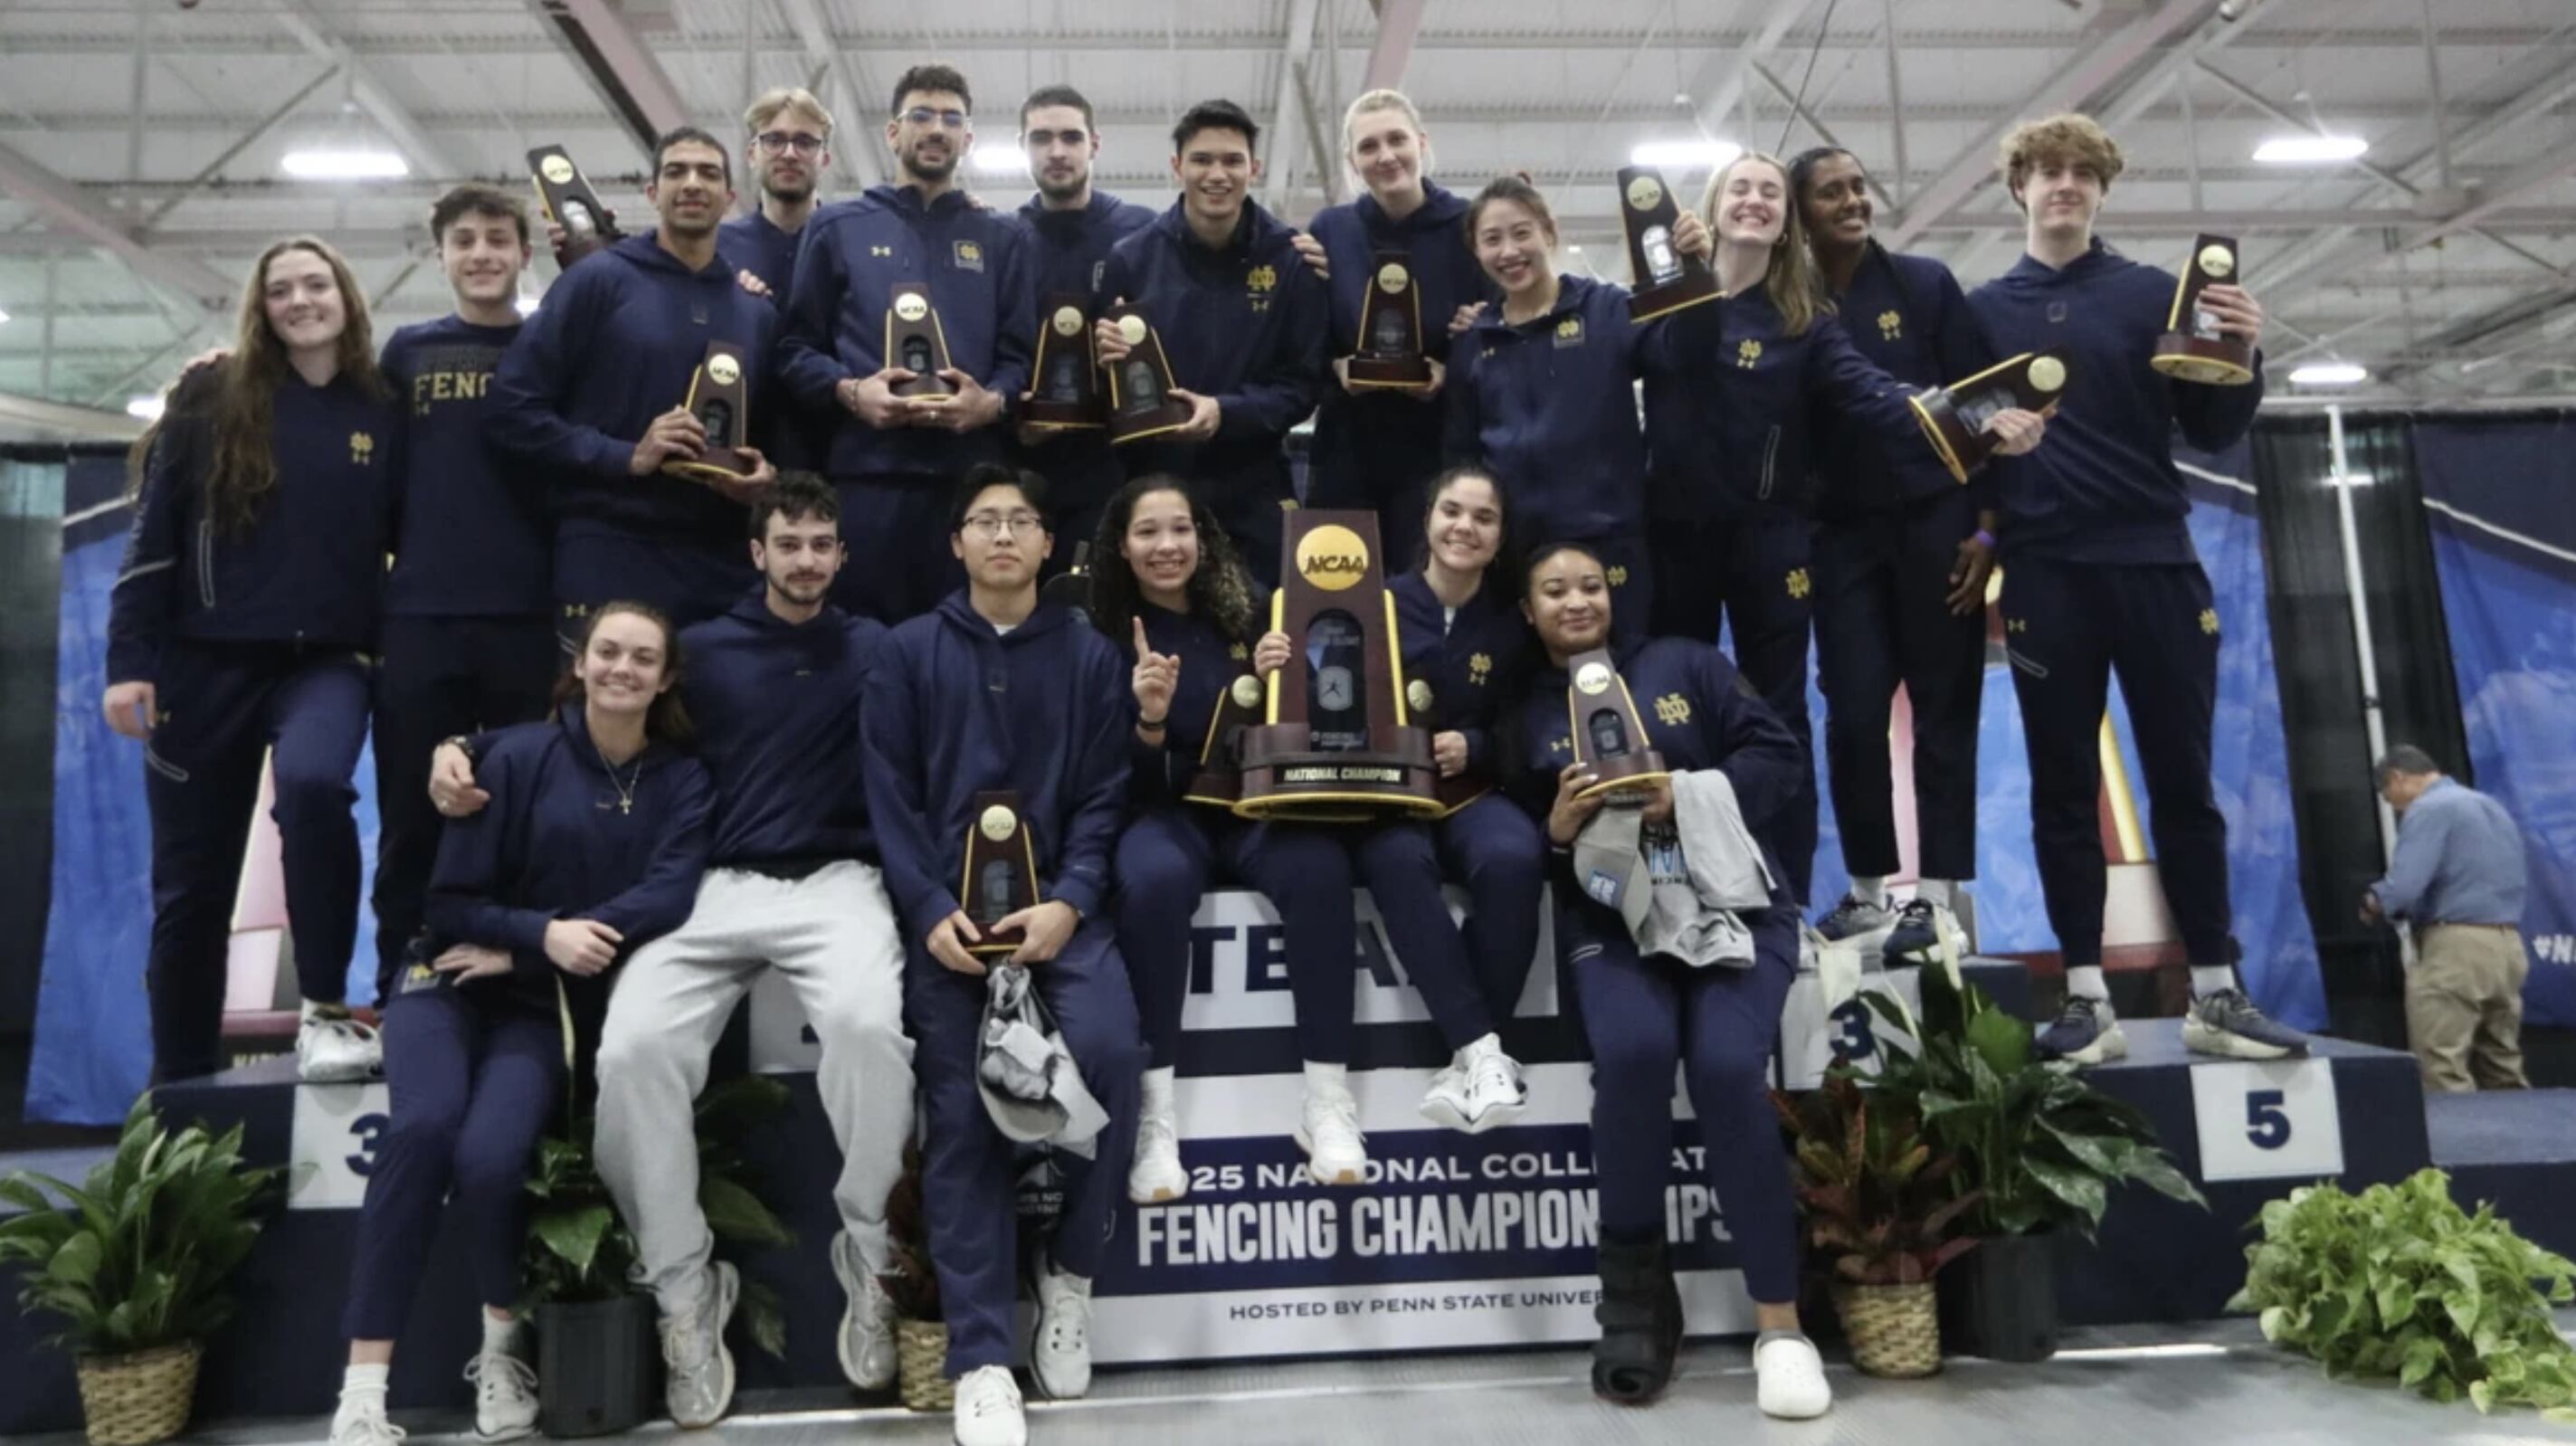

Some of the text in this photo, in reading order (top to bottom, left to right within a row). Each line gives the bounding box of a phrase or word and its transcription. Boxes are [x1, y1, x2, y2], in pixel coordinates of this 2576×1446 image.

[1304, 555, 1364, 576] NCAA
[1283, 766, 1402, 782] NATIONAL CHAMPION
[1828, 999, 1876, 1060] 3
[345, 1112, 390, 1176] 3
[2245, 1089, 2292, 1150] 5
[1189, 1165, 1245, 1192] 25
[1257, 1155, 1471, 1189] NAONAL
[1137, 1184, 1733, 1267] FENCING CHAMPIONIPS
[1230, 1289, 1604, 1320] HOSTED BY PENN STATE UNIVER
